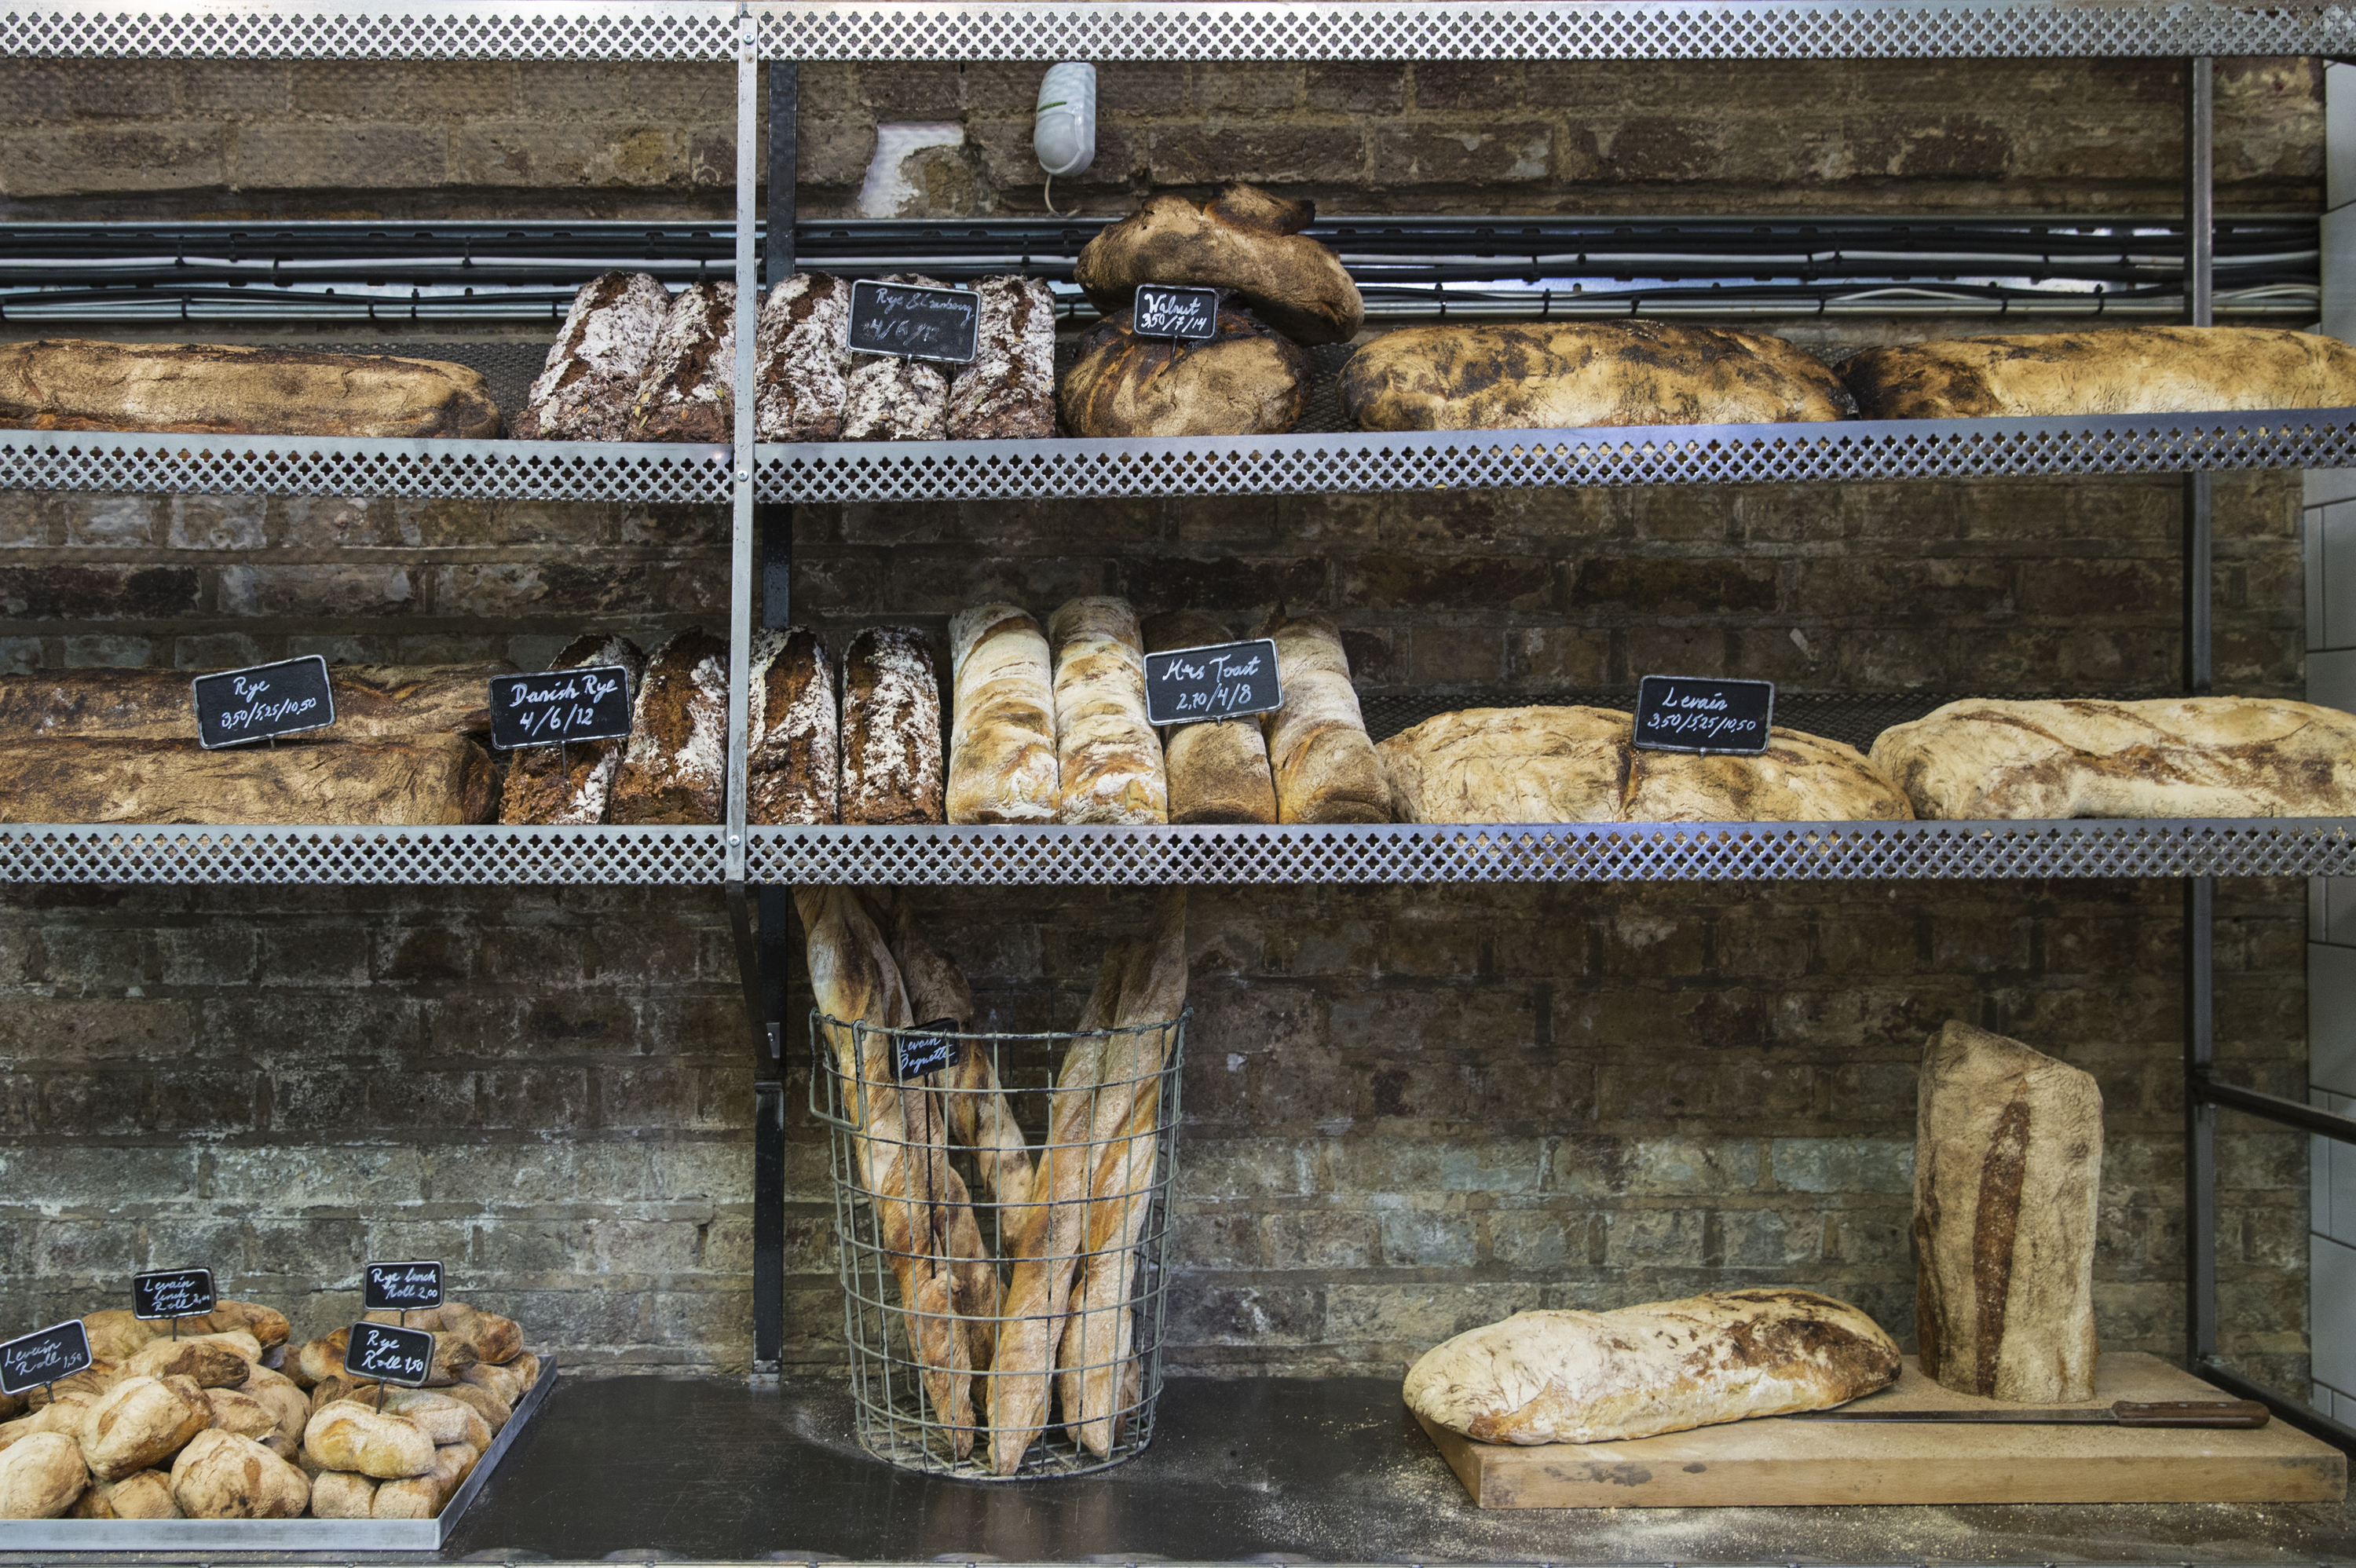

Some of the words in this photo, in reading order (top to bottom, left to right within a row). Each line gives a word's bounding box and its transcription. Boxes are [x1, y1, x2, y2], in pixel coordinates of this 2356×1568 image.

[876, 287, 903, 314] Rye
[1144, 293, 1202, 316] Walnut
[1141, 313, 1207, 333] 3,50/7/14
[1209, 654, 1261, 682] Toast
[233, 676, 270, 703] Rye
[510, 679, 580, 707] Danish
[581, 674, 618, 704] Rye
[1662, 686, 1728, 711] Levain
[221, 697, 316, 729] 3,50/5,25/10,50
[519, 704, 594, 736] 4/6/12
[1647, 713, 1756, 738] 3,50/5,25/10,50
[899, 1036, 942, 1053] Levain
[899, 1044, 956, 1074] Baguette
[144, 1276, 196, 1292] Levain
[371, 1267, 401, 1290] Rye
[384, 1284, 415, 1300] Roll
[418, 1287, 438, 1299] 2,00
[152, 1299, 194, 1311] Roll
[4, 1340, 62, 1367] Levain
[367, 1329, 400, 1356] Rye
[15, 1351, 61, 1376] Roll
[64, 1352, 82, 1369] 1,50
[361, 1350, 402, 1369] Roll
[405, 1356, 423, 1373] 1,50
